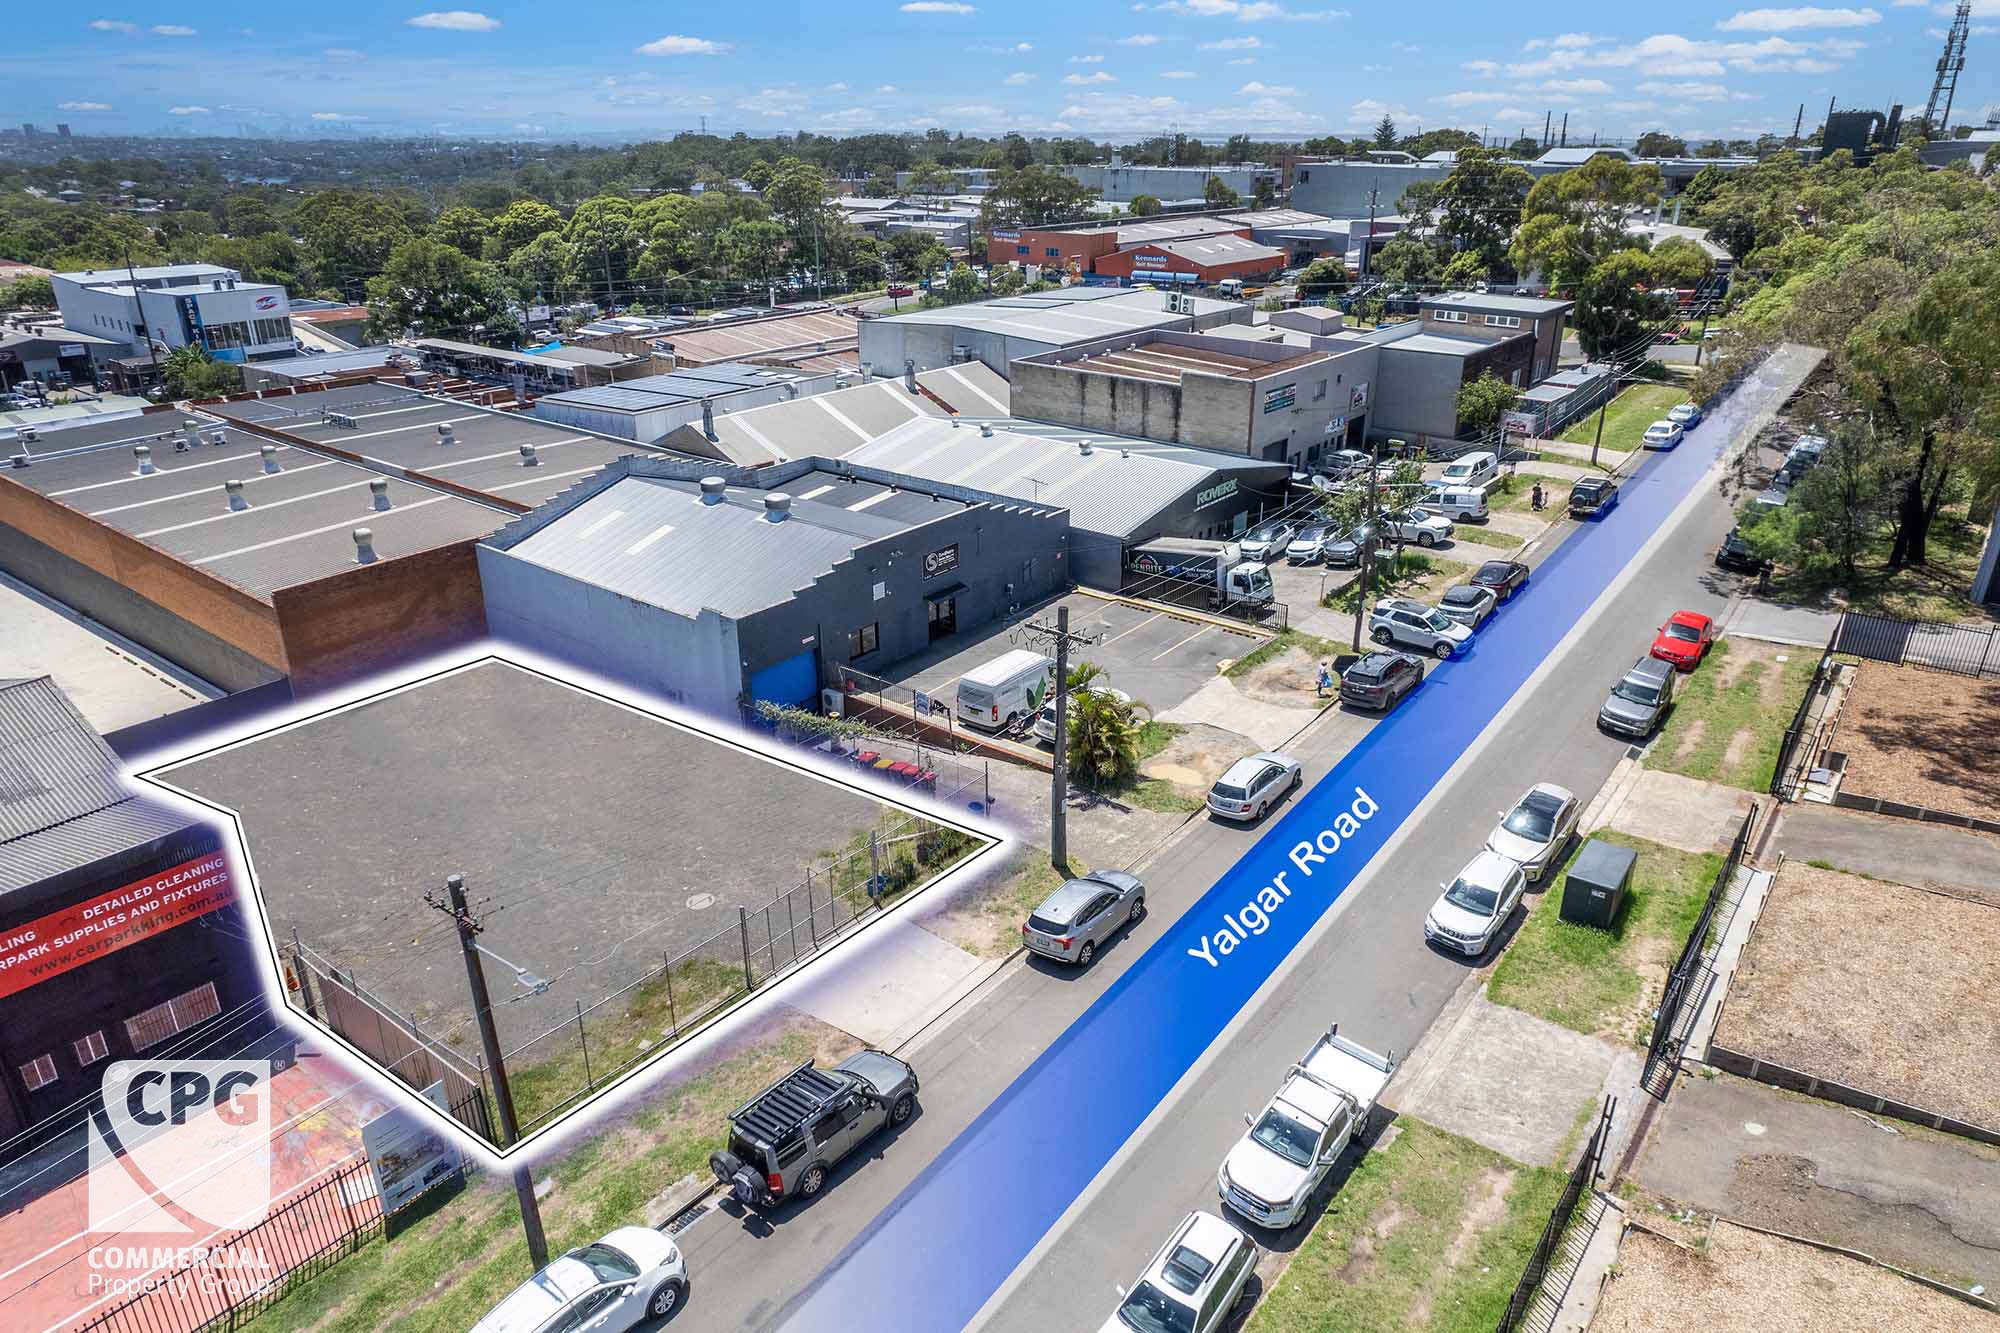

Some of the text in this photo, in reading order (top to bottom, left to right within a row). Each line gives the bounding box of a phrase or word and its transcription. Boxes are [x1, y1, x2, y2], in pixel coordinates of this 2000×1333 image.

[1135, 254, 1167, 262] Kennards
[184, 297, 197, 325] SPACE
[54, 913, 126, 949] SUPPLIES
[131, 900, 160, 919] AND
[163, 872, 228, 905] FIXTURES
[82, 886, 152, 920] DETAILED
[156, 858, 224, 890] CLEANING
